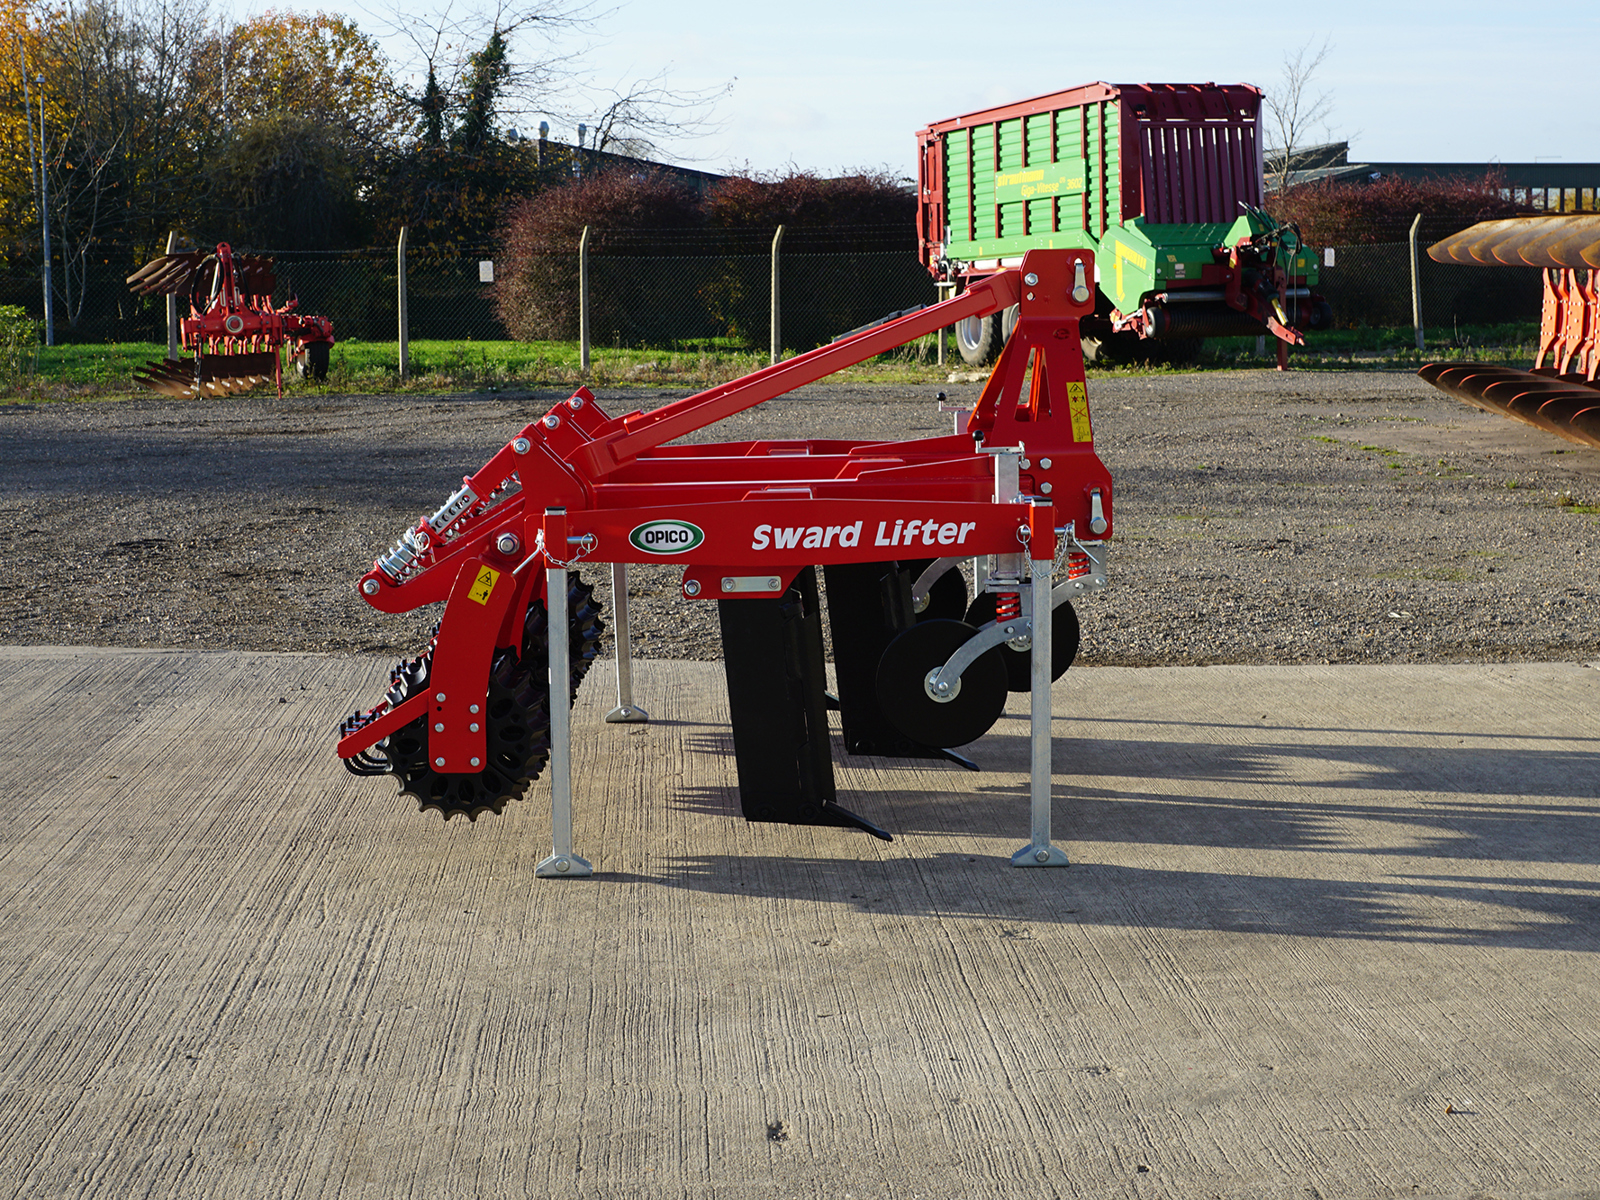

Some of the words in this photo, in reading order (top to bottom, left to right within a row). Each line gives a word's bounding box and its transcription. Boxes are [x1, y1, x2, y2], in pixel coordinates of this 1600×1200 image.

[1066, 177, 1083, 190] 3602
[645, 530, 688, 544] OPICO
[751, 520, 863, 550] Sward
[874, 518, 976, 546] Lifter
